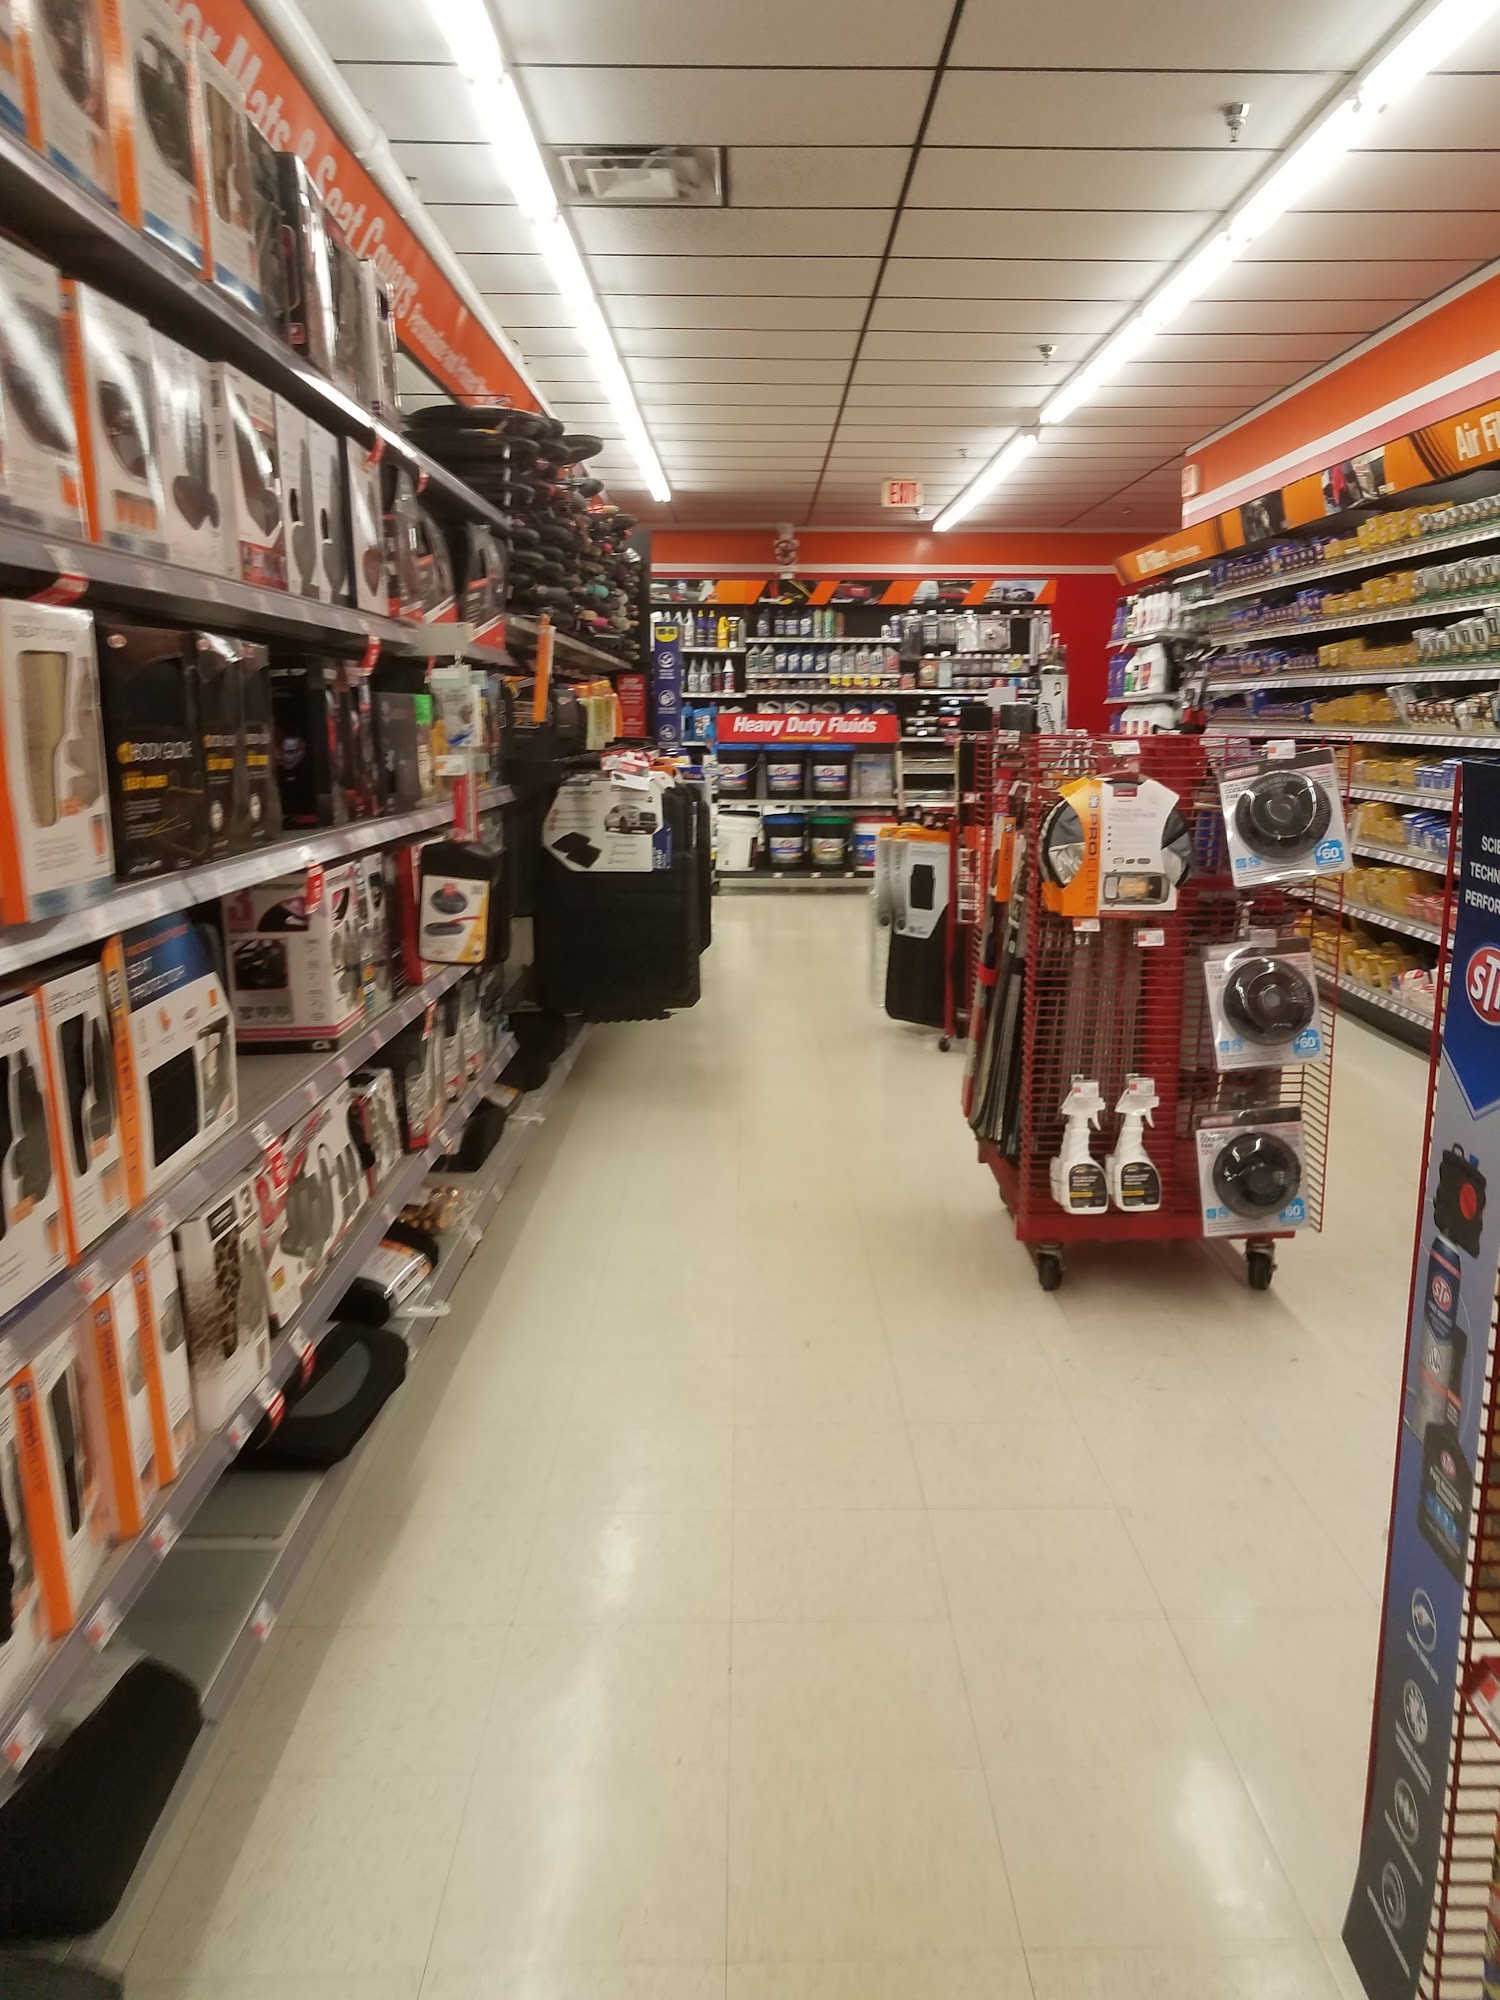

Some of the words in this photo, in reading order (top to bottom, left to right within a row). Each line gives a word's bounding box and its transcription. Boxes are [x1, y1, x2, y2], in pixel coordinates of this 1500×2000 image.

[1455, 422, 1481, 461] Air
[733, 716, 785, 736] Heavy
[786, 717, 827, 736] Duty
[826, 717, 877, 733] Fluids
[1434, 1281, 1451, 1304] STP
